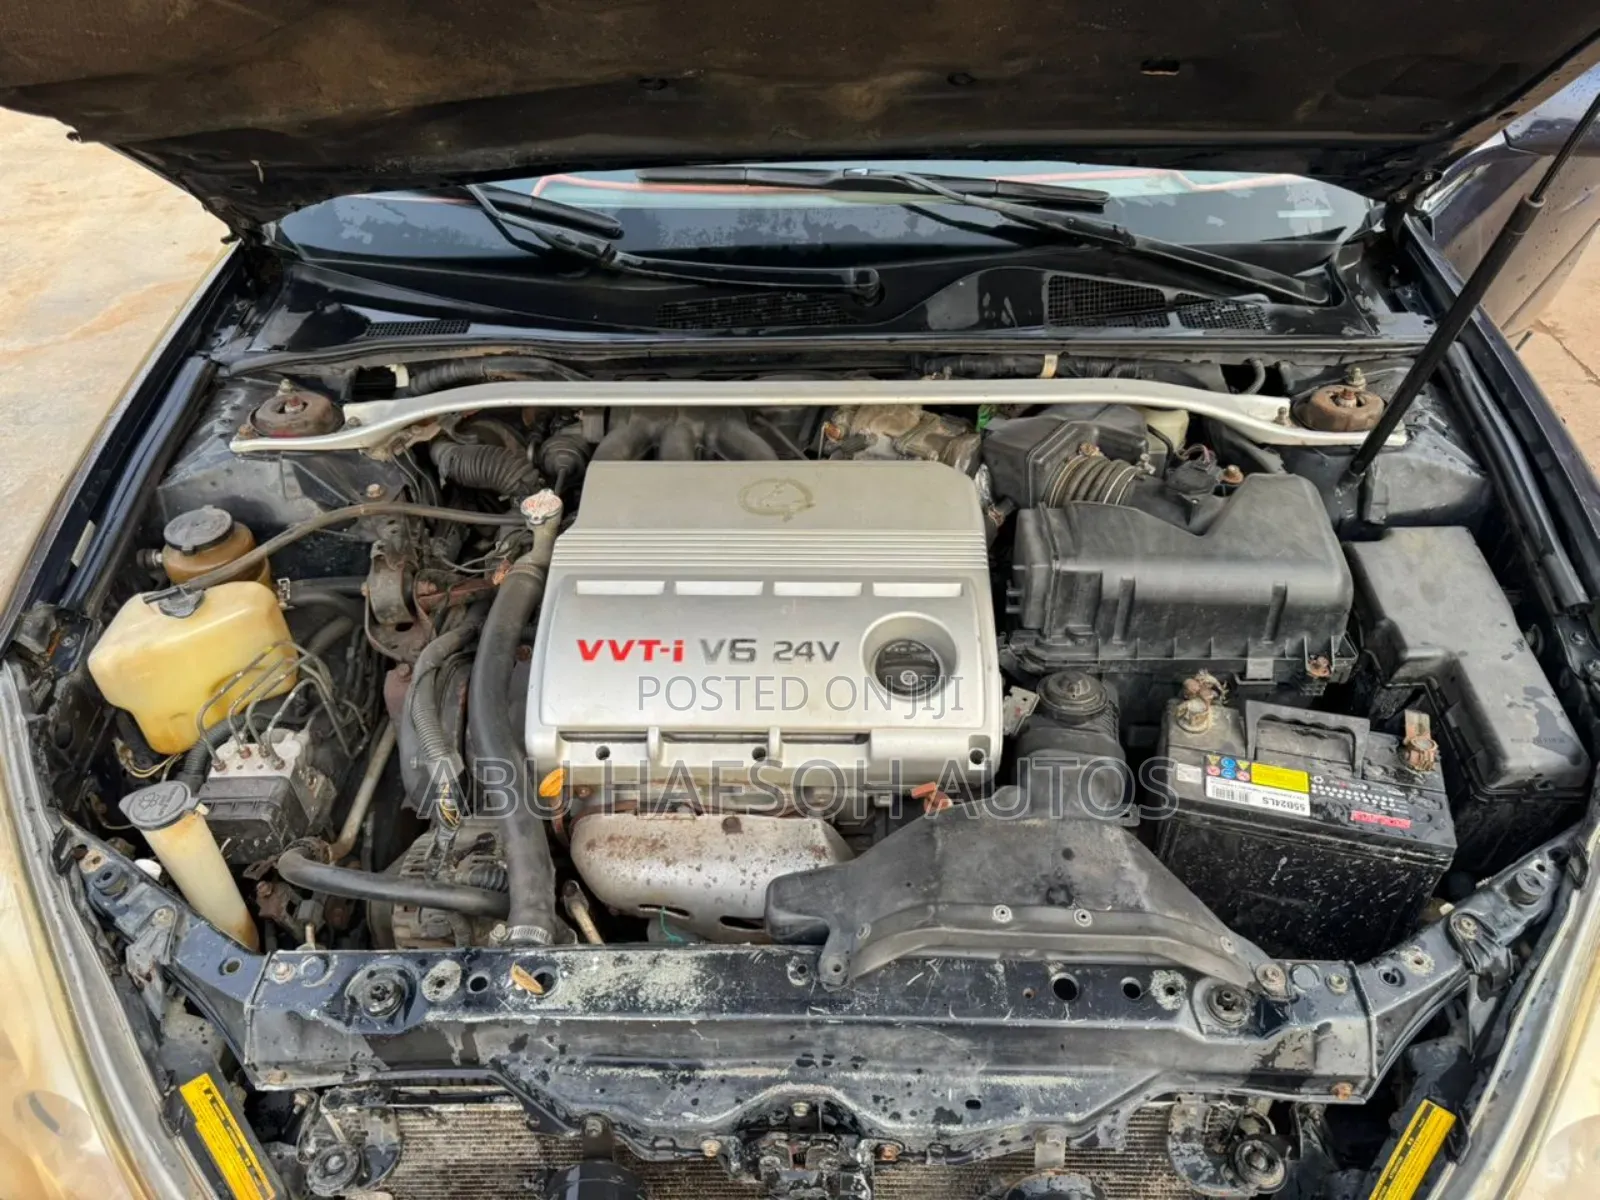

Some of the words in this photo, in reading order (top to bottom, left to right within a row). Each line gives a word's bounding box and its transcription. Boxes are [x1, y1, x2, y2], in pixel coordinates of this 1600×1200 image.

[576, 639, 685, 662] VVT-i
[698, 639, 757, 664] V6
[773, 640, 841, 663] 24V
[1262, 796, 1306, 812] 55B24LS
